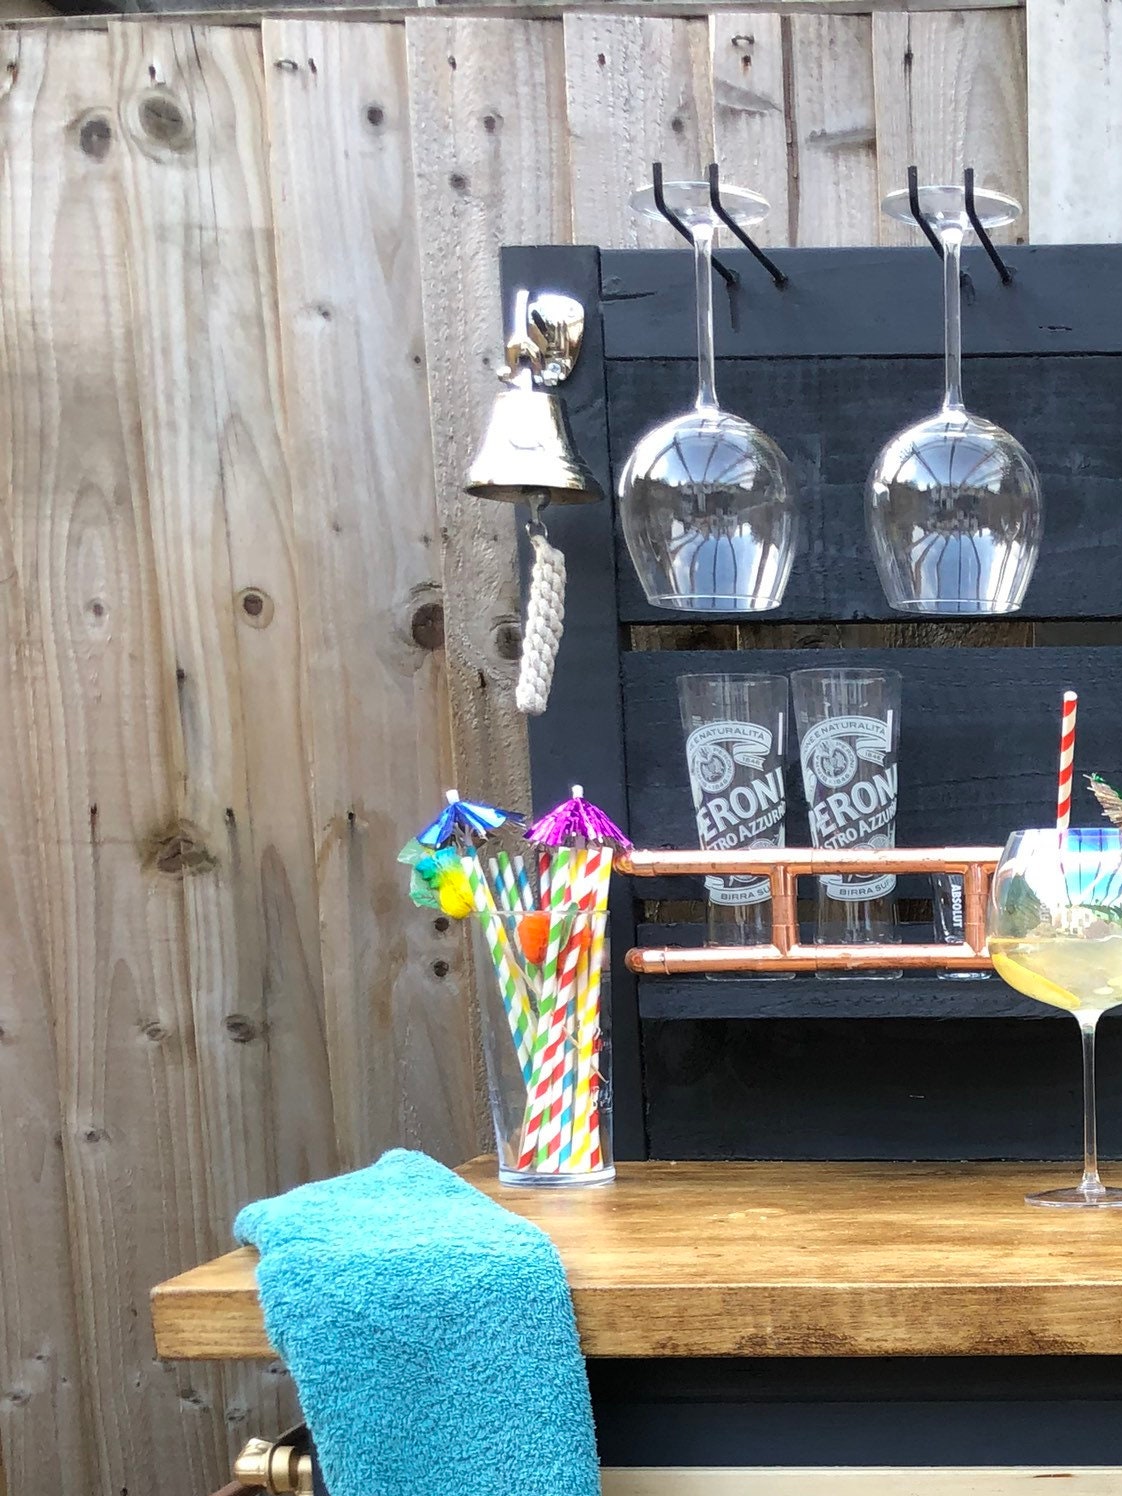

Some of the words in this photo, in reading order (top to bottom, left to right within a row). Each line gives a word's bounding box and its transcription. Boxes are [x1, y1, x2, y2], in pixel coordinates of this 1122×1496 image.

[697, 766, 785, 842] ERONI
[720, 890, 755, 901] BIRRA
[839, 886, 874, 897] BIRRA
[951, 884, 963, 929] ABSOLUT
